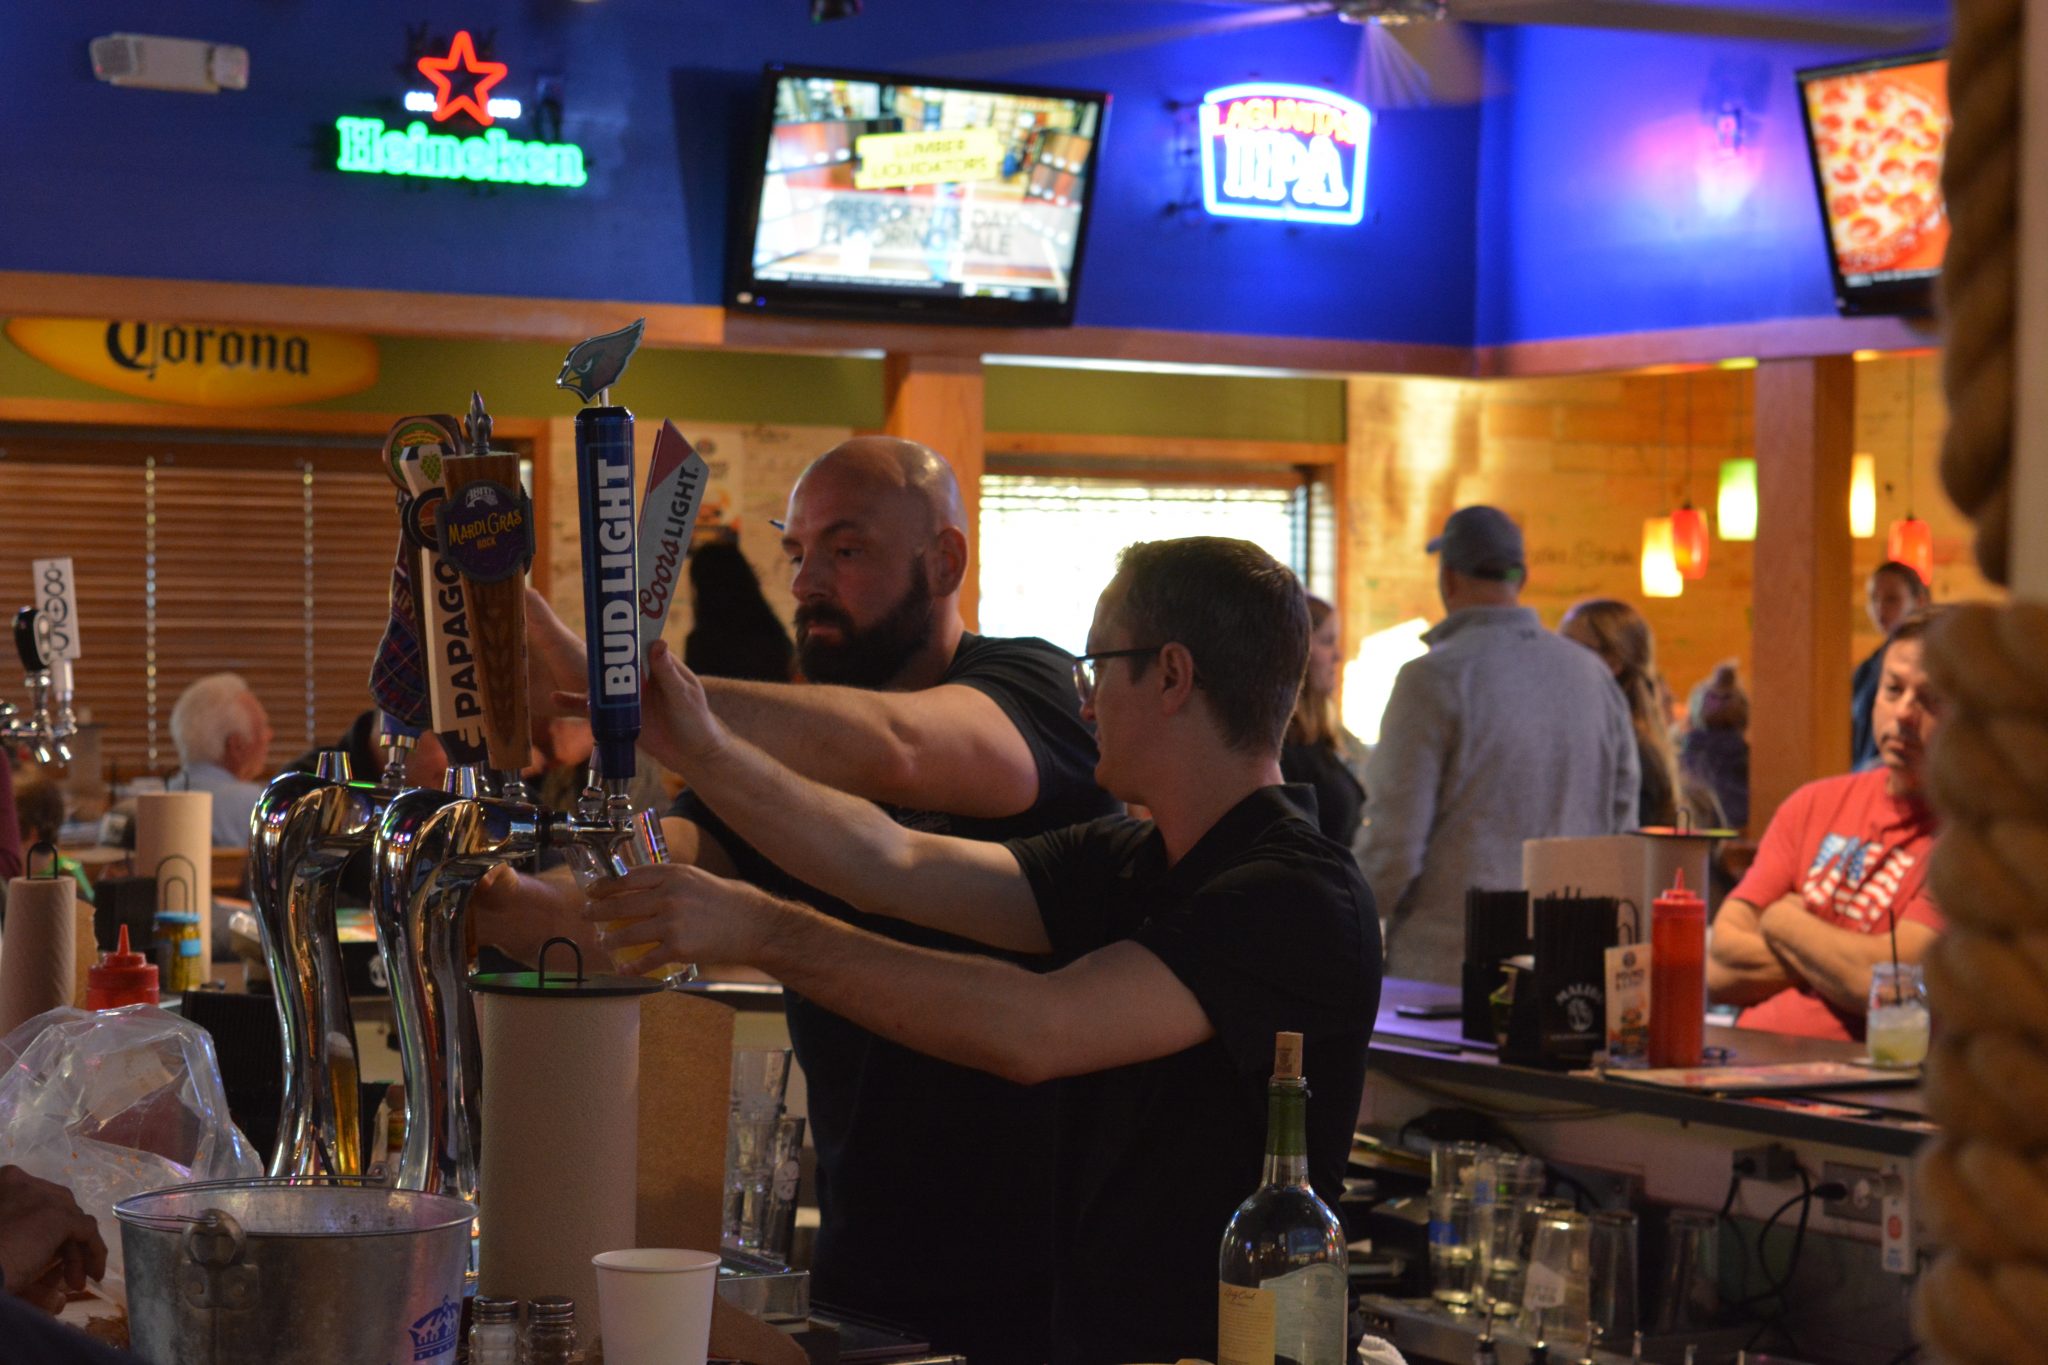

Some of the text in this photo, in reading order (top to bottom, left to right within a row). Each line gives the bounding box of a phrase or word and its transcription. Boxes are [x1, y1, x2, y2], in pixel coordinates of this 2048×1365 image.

[337, 117, 587, 187] Heineken
[896, 138, 966, 158] MBER
[1222, 129, 1349, 208] IPA
[106, 321, 309, 379] Corona
[448, 509, 522, 546] MARDI GRAS
[597, 458, 637, 696] BUD LIGHT
[639, 538, 681, 620] Coors
[434, 558, 483, 719] PAPAGO
